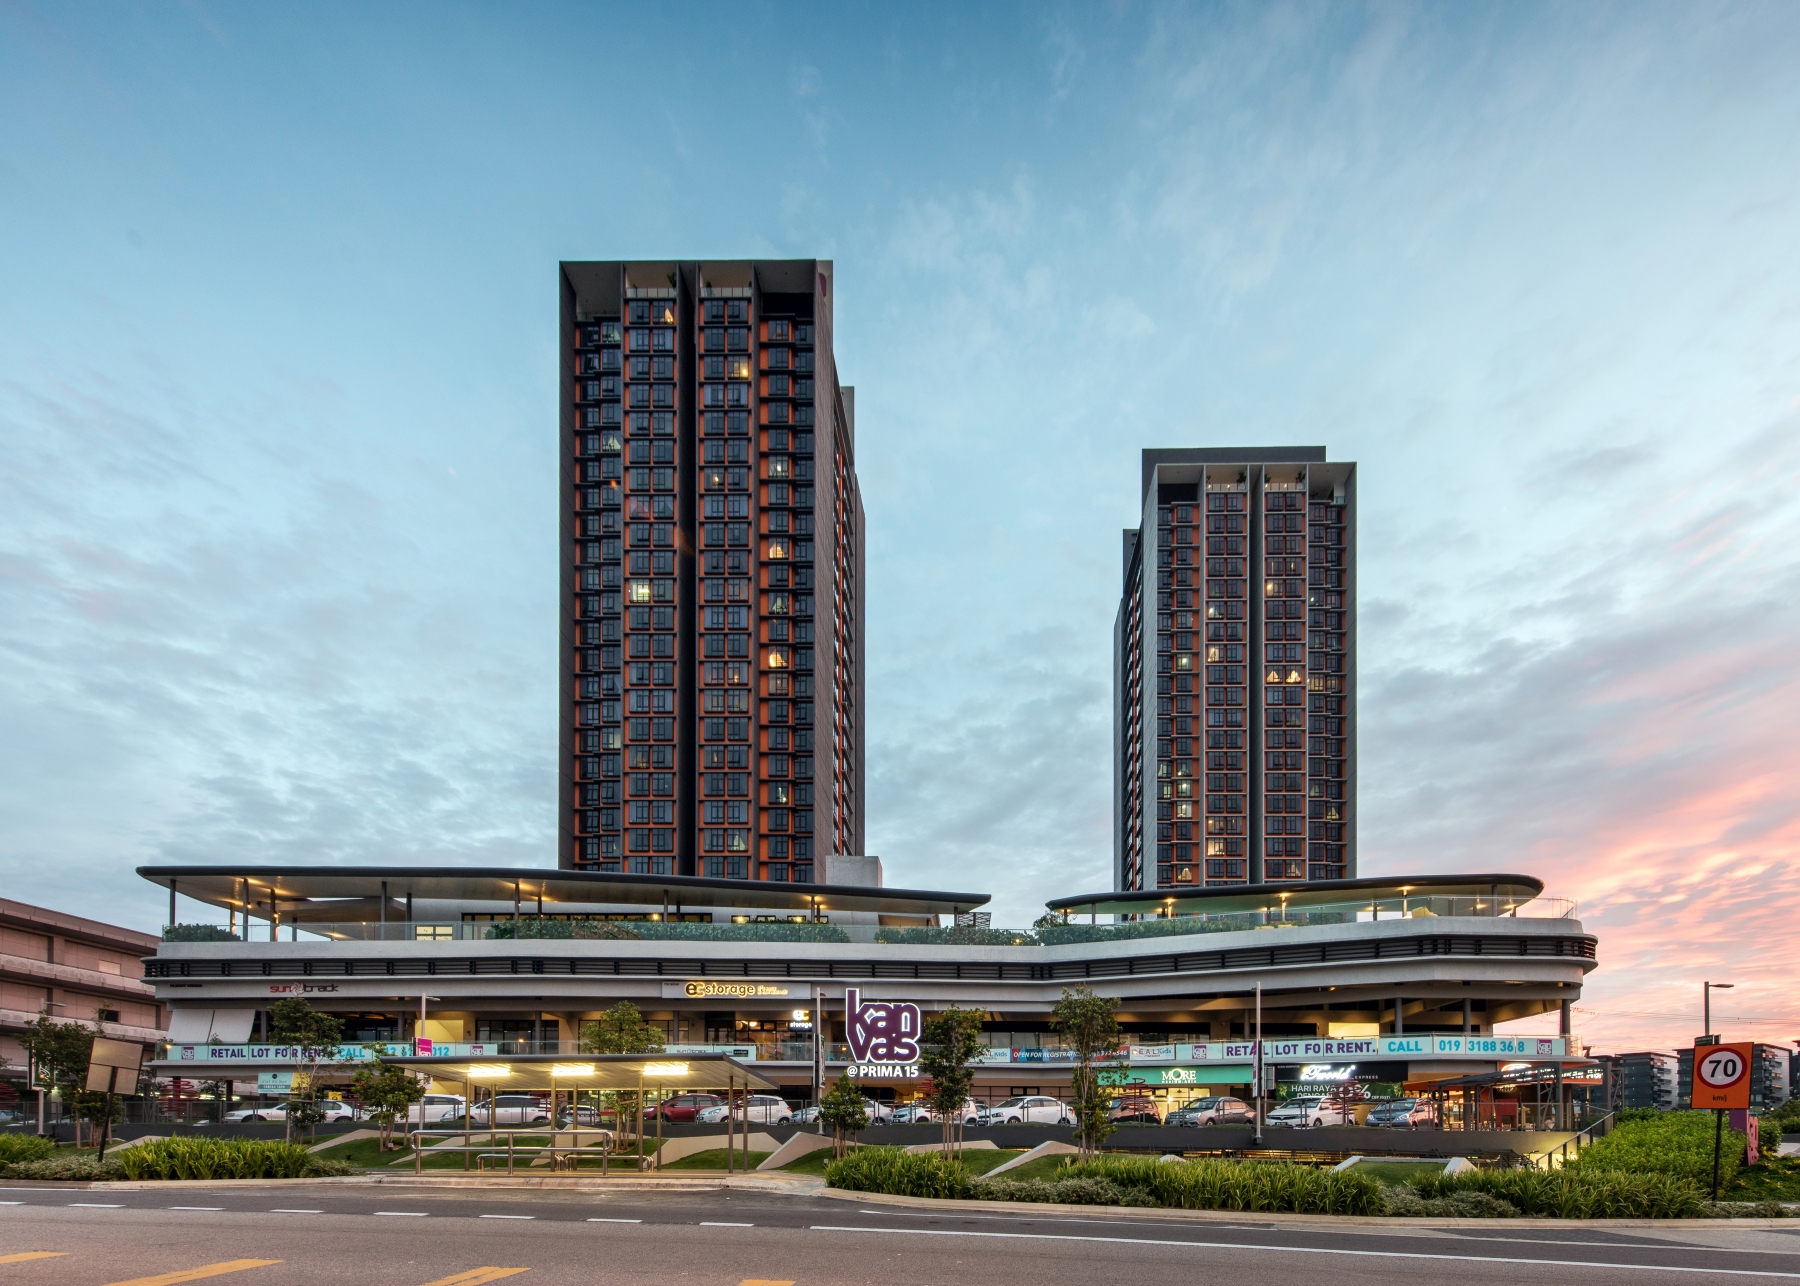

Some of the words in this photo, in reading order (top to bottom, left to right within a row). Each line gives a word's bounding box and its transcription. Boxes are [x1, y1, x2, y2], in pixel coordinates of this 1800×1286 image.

[705, 982, 756, 998] storage
[211, 1048, 246, 1058] RETAIL
[251, 1048, 270, 1058] LOT
[338, 1047, 366, 1058] CALL
[1275, 1043, 1299, 1056] LOT
[1387, 1040, 1423, 1053] CALL
[1438, 1039, 1461, 1052] 019
[1468, 1039, 1497, 1052] 3188
[847, 1066, 858, 1077] @
[860, 1066, 903, 1078] PRIMA
[904, 1066, 919, 1078] 15
[1161, 1068, 1197, 1081] MORE
[1709, 1059, 1737, 1078] 70
